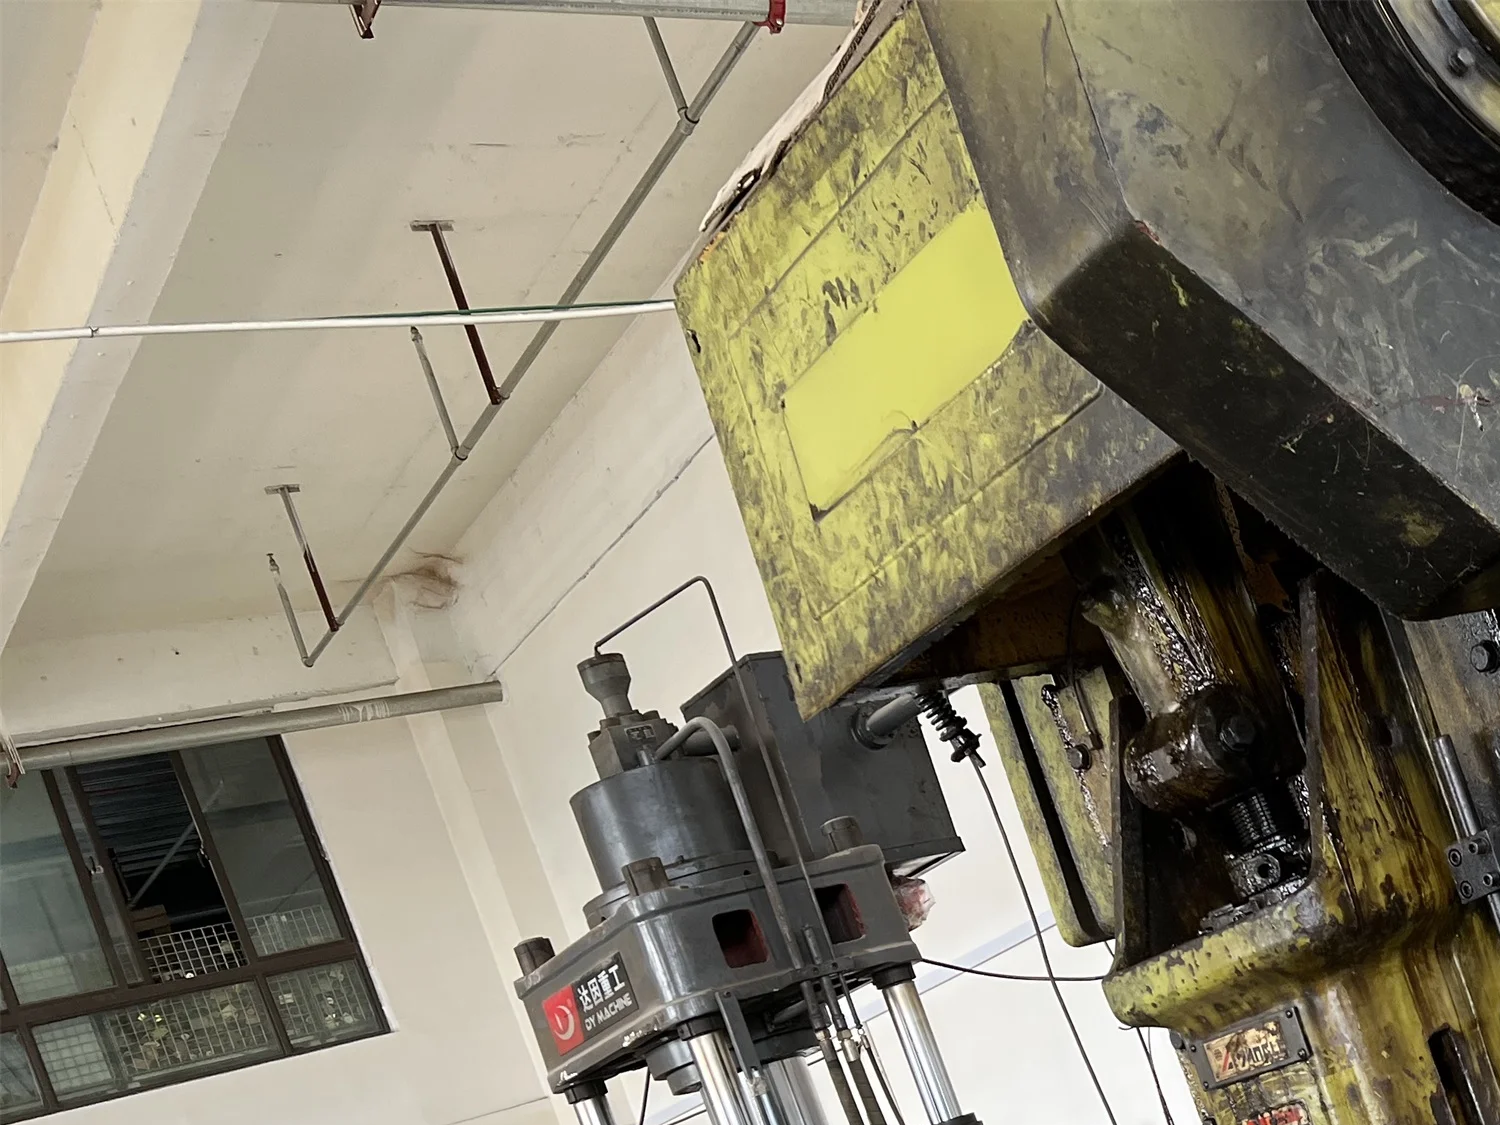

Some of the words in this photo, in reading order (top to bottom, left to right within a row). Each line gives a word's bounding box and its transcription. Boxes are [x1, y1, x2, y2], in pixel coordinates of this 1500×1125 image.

[577, 964, 626, 1013] 达因重工
[584, 1014, 597, 1031] DY
[596, 992, 633, 1025] MACHINE
